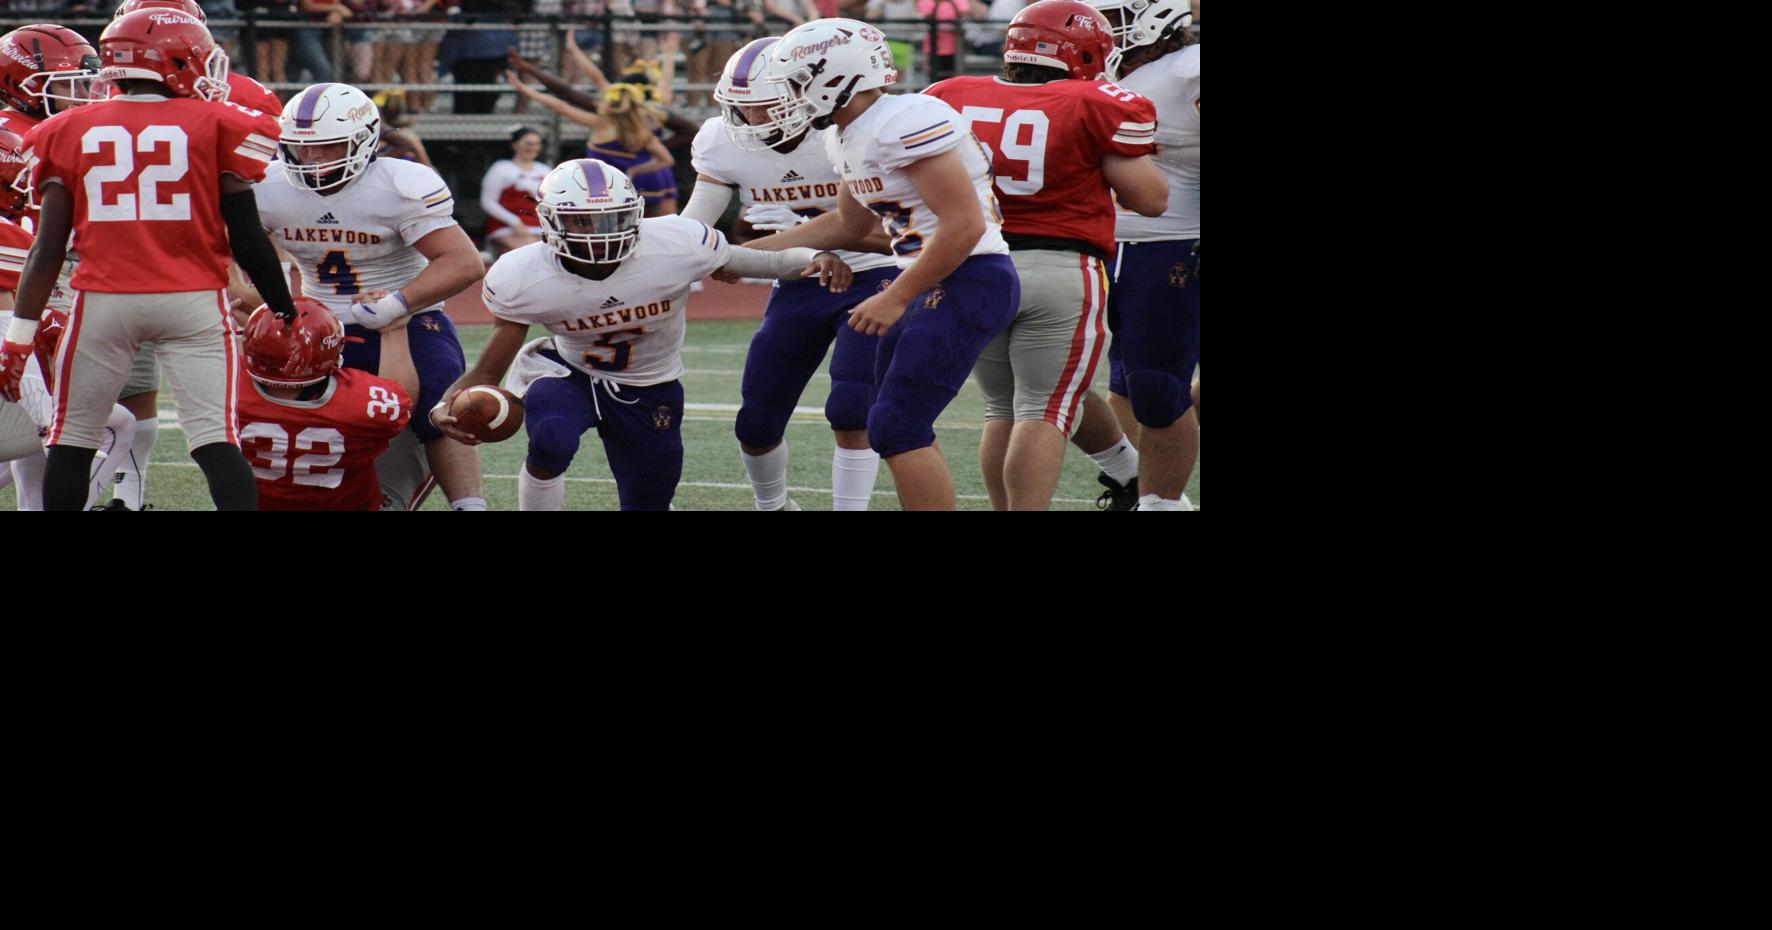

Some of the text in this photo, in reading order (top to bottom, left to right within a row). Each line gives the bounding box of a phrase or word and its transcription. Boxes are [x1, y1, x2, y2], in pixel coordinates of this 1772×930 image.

[790, 34, 850, 63] Rangers
[727, 87, 751, 95] Riddell
[1098, 84, 1141, 102] 5
[347, 101, 373, 123] Rang
[961, 106, 1050, 196] 59
[81, 124, 192, 222] 22
[751, 182, 841, 203] LAKEWOO
[283, 227, 381, 245] LAKEWOOD
[316, 248, 362, 296] 4
[561, 299, 672, 332] LAKEWOOD
[581, 323, 646, 372] 5
[366, 385, 401, 422] 32
[239, 422, 346, 490] 32
